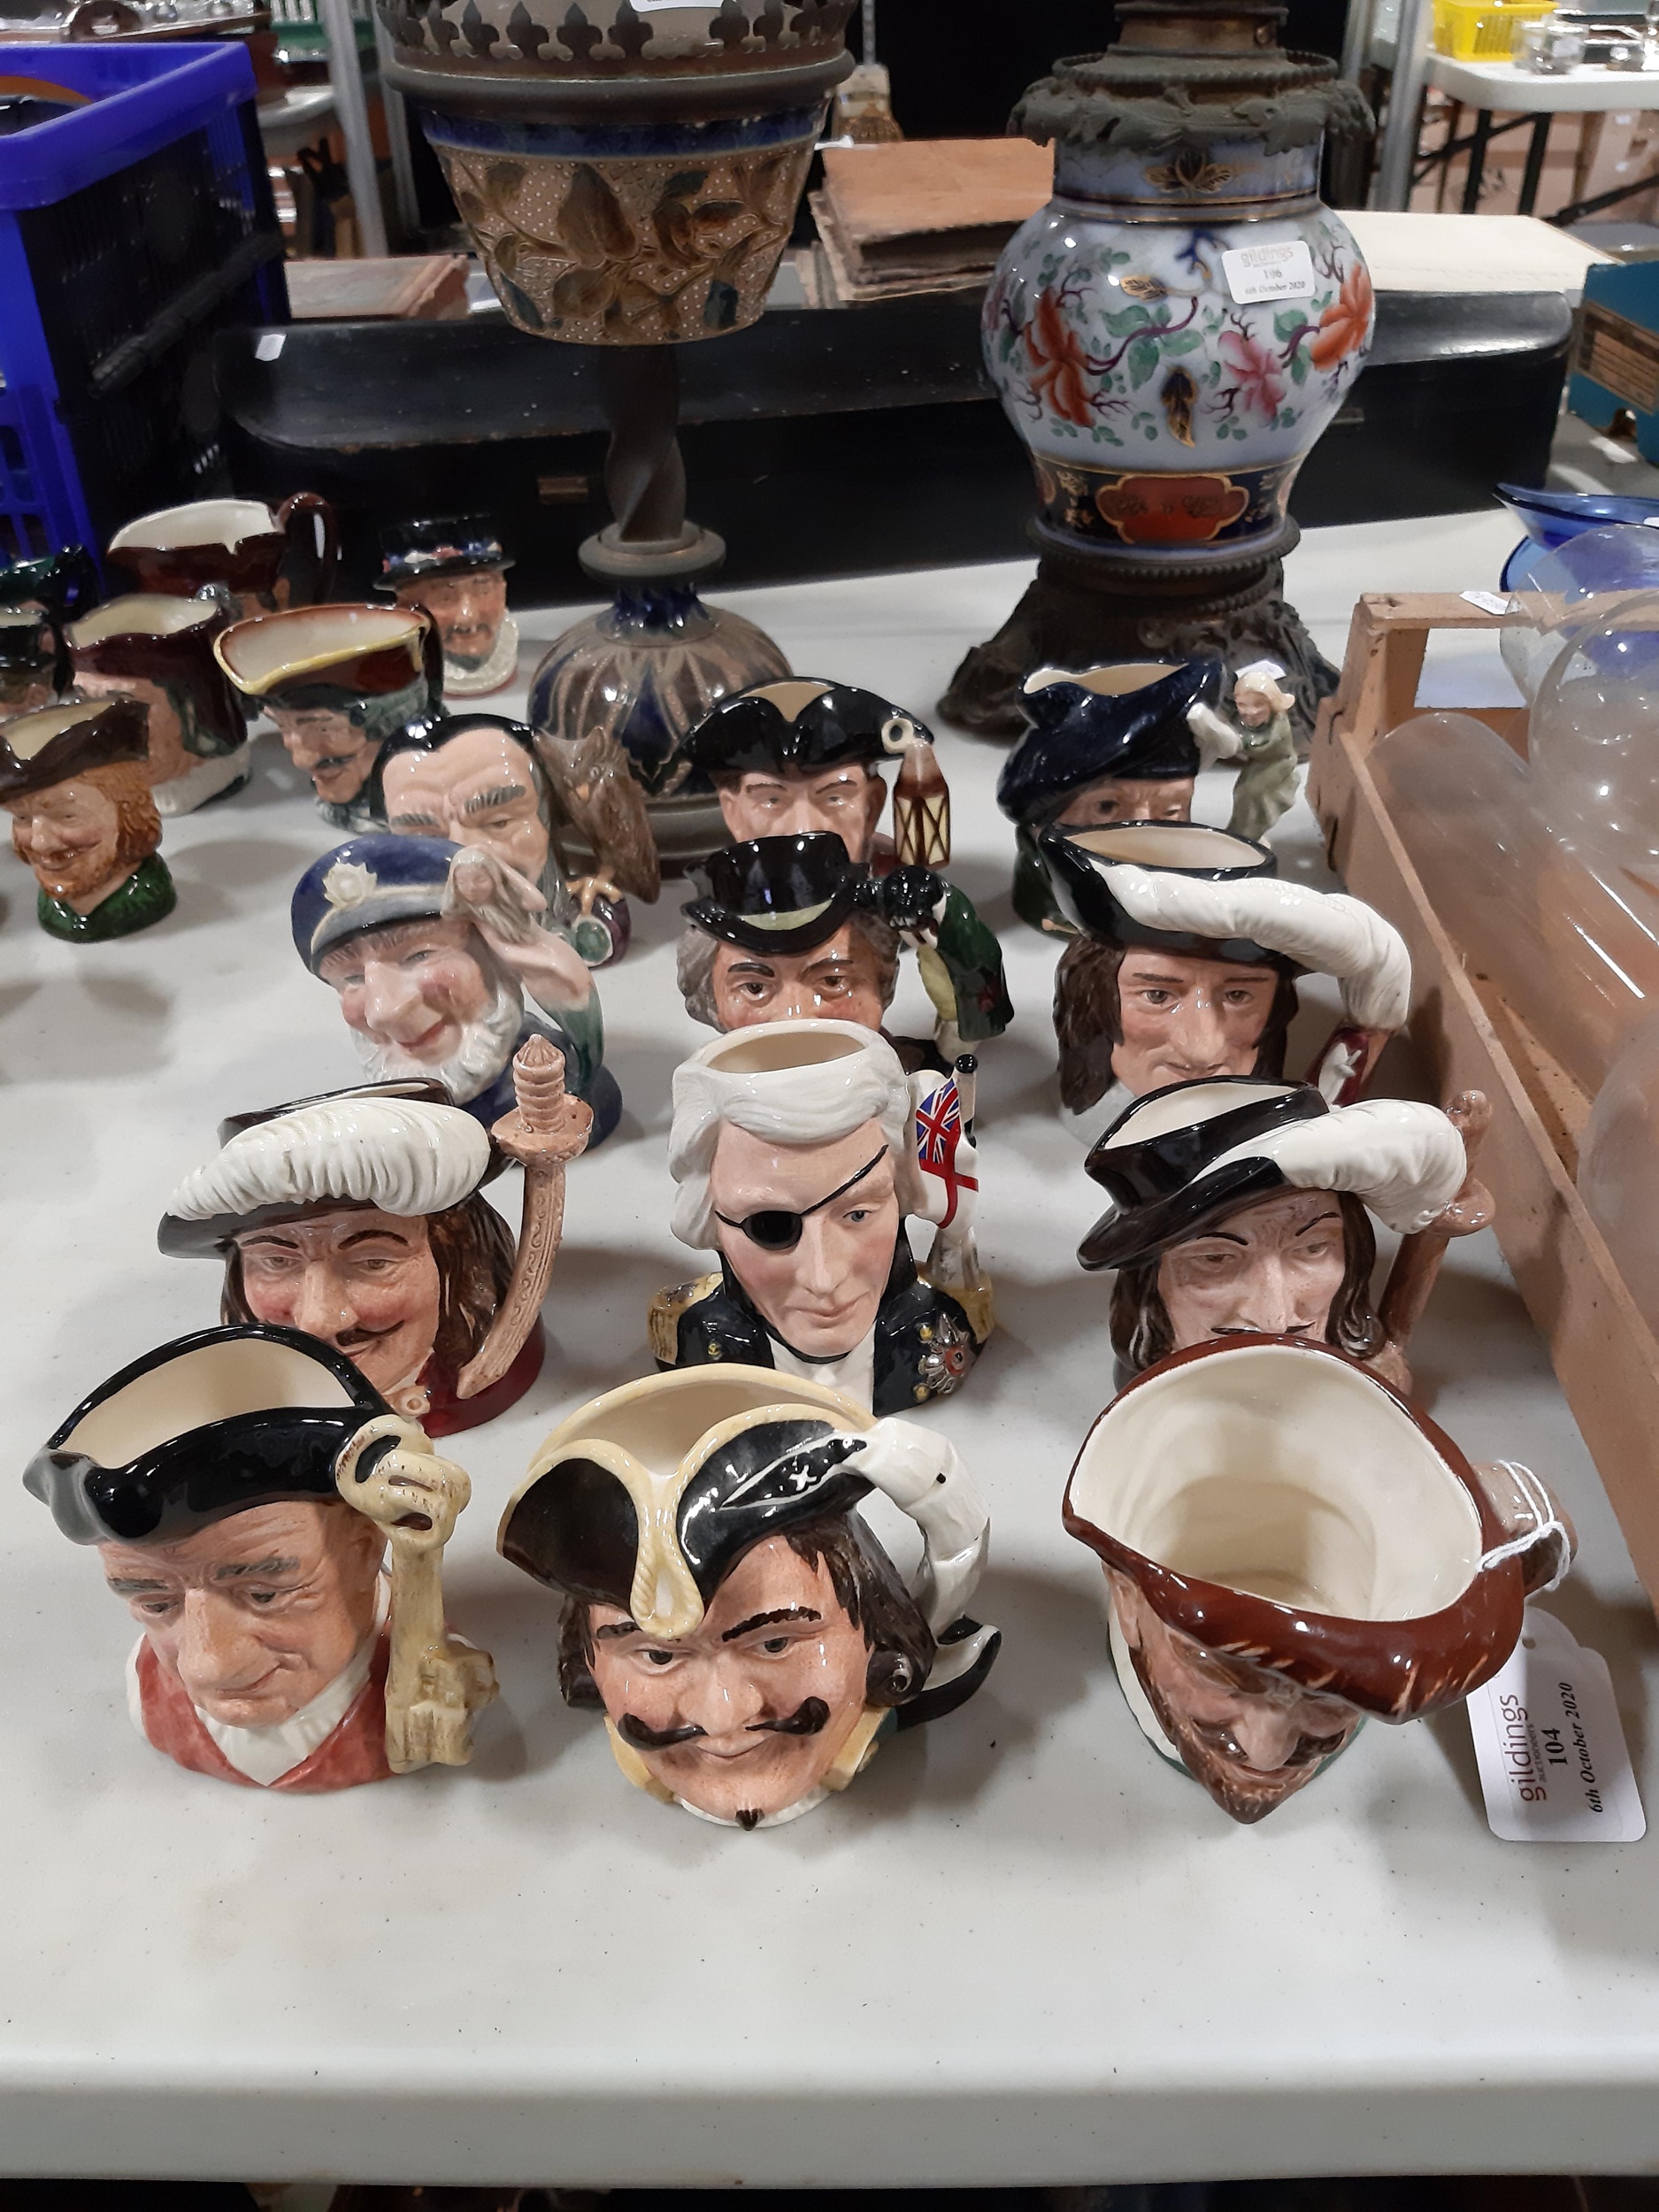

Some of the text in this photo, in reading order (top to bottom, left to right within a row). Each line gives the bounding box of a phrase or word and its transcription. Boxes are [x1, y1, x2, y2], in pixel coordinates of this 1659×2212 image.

[1241, 248, 1293, 267] gildings
[1500, 1694, 1548, 1801] gildings
[1541, 1728, 1569, 1766] 104
[1557, 1682, 1603, 1813] 6th October 2020
